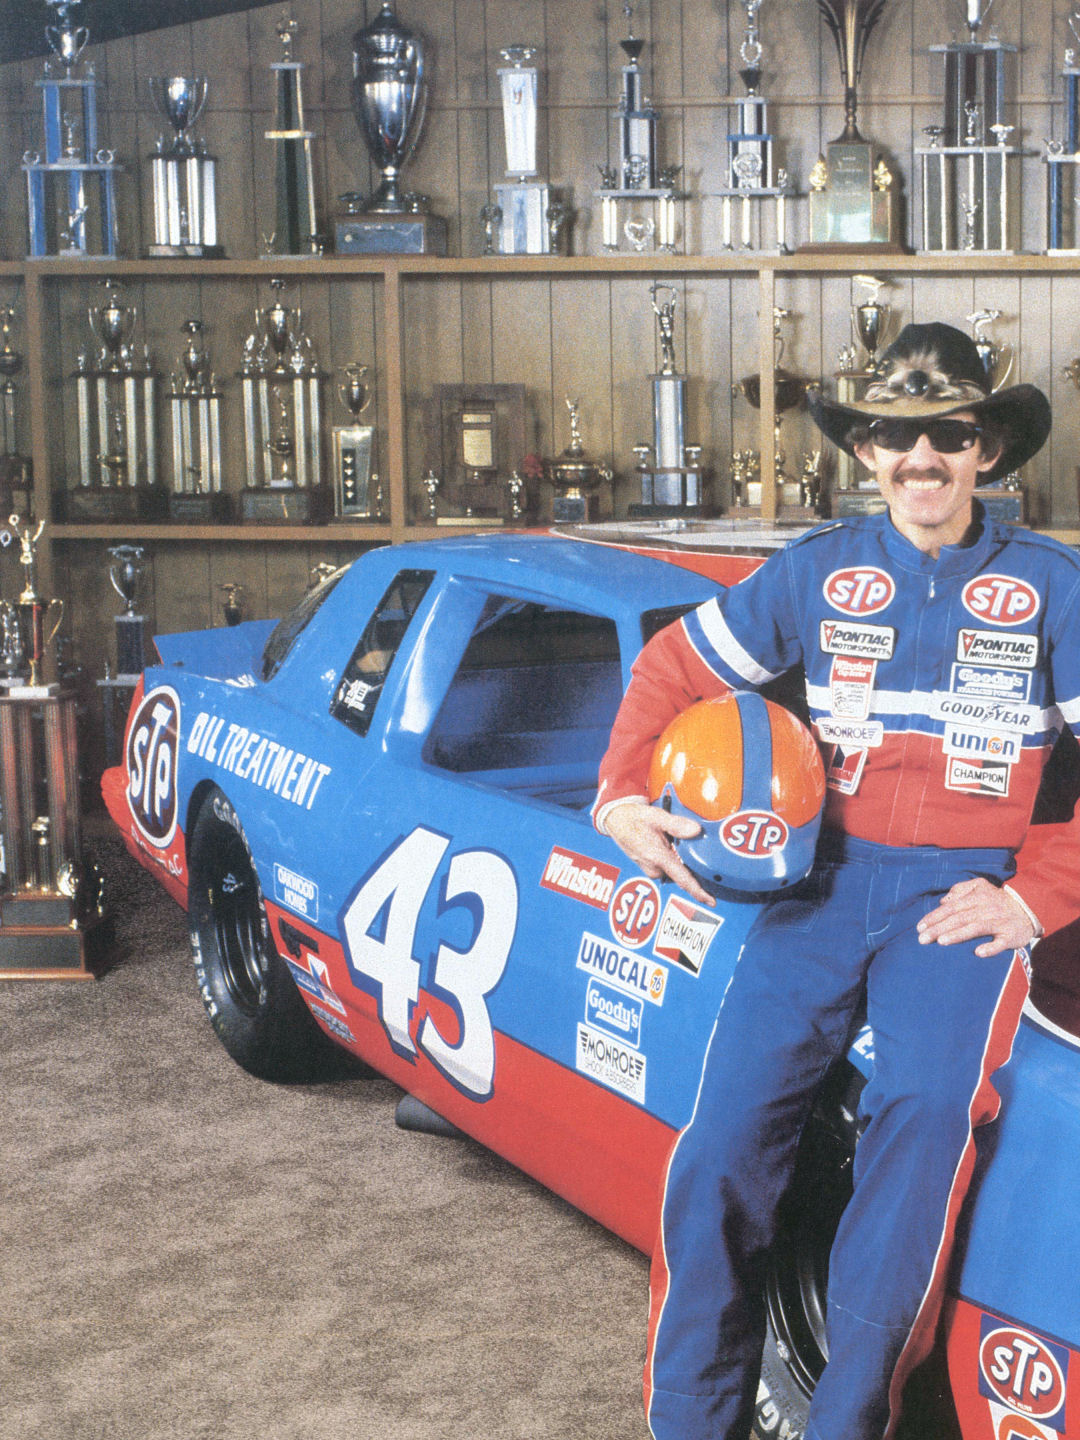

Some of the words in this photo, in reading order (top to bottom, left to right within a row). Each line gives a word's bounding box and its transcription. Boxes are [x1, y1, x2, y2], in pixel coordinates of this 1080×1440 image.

[831, 574, 887, 608] STP
[970, 581, 1032, 618] STP
[830, 643, 889, 656] MOTORSPORTS
[834, 630, 891, 647] PONTIAC
[969, 651, 1031, 663] MOTORSPORTS
[974, 639, 1034, 655] PONTIAC
[828, 725, 869, 739] MONROE
[131, 702, 171, 820] STP
[187, 712, 218, 764] OIL
[217, 727, 331, 810] TREATMENT
[953, 768, 1005, 785] CHAMPION
[727, 816, 781, 852] STP
[544, 853, 614, 903] Winston
[615, 883, 655, 933] STP
[663, 917, 705, 951] CHAMPION
[343, 827, 520, 1098] 43
[580, 943, 648, 990] UNOCAL
[651, 976, 663, 993] 76
[589, 989, 638, 1028] Goody's
[587, 1038, 634, 1078] MONROE
[990, 1337, 1053, 1399] STP
